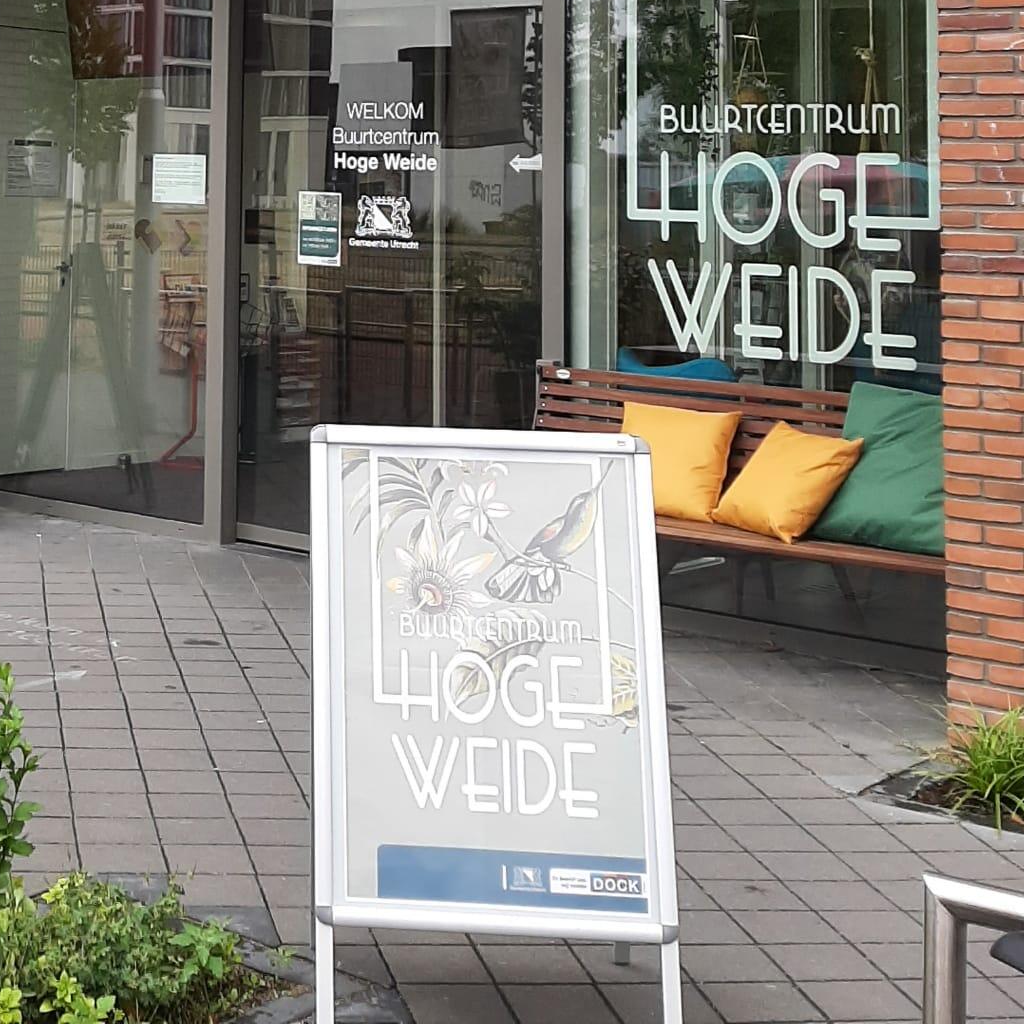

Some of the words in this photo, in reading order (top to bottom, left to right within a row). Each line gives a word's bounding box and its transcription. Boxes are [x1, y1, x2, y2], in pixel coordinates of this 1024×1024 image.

[347, 102, 424, 120] WELKOM
[660, 103, 901, 134] BUURTCENTRUM
[332, 127, 440, 145] Buurtcentrum
[334, 152, 379, 173] Hoge
[383, 153, 438, 171] Weide
[660, 150, 903, 252] HOGE
[647, 258, 918, 371] WEIDE
[399, 612, 582, 644] BUURTCENTRUM
[400, 648, 586, 730] HOGE
[391, 733, 599, 818] WEIDE
[593, 877, 640, 893] DOCK
